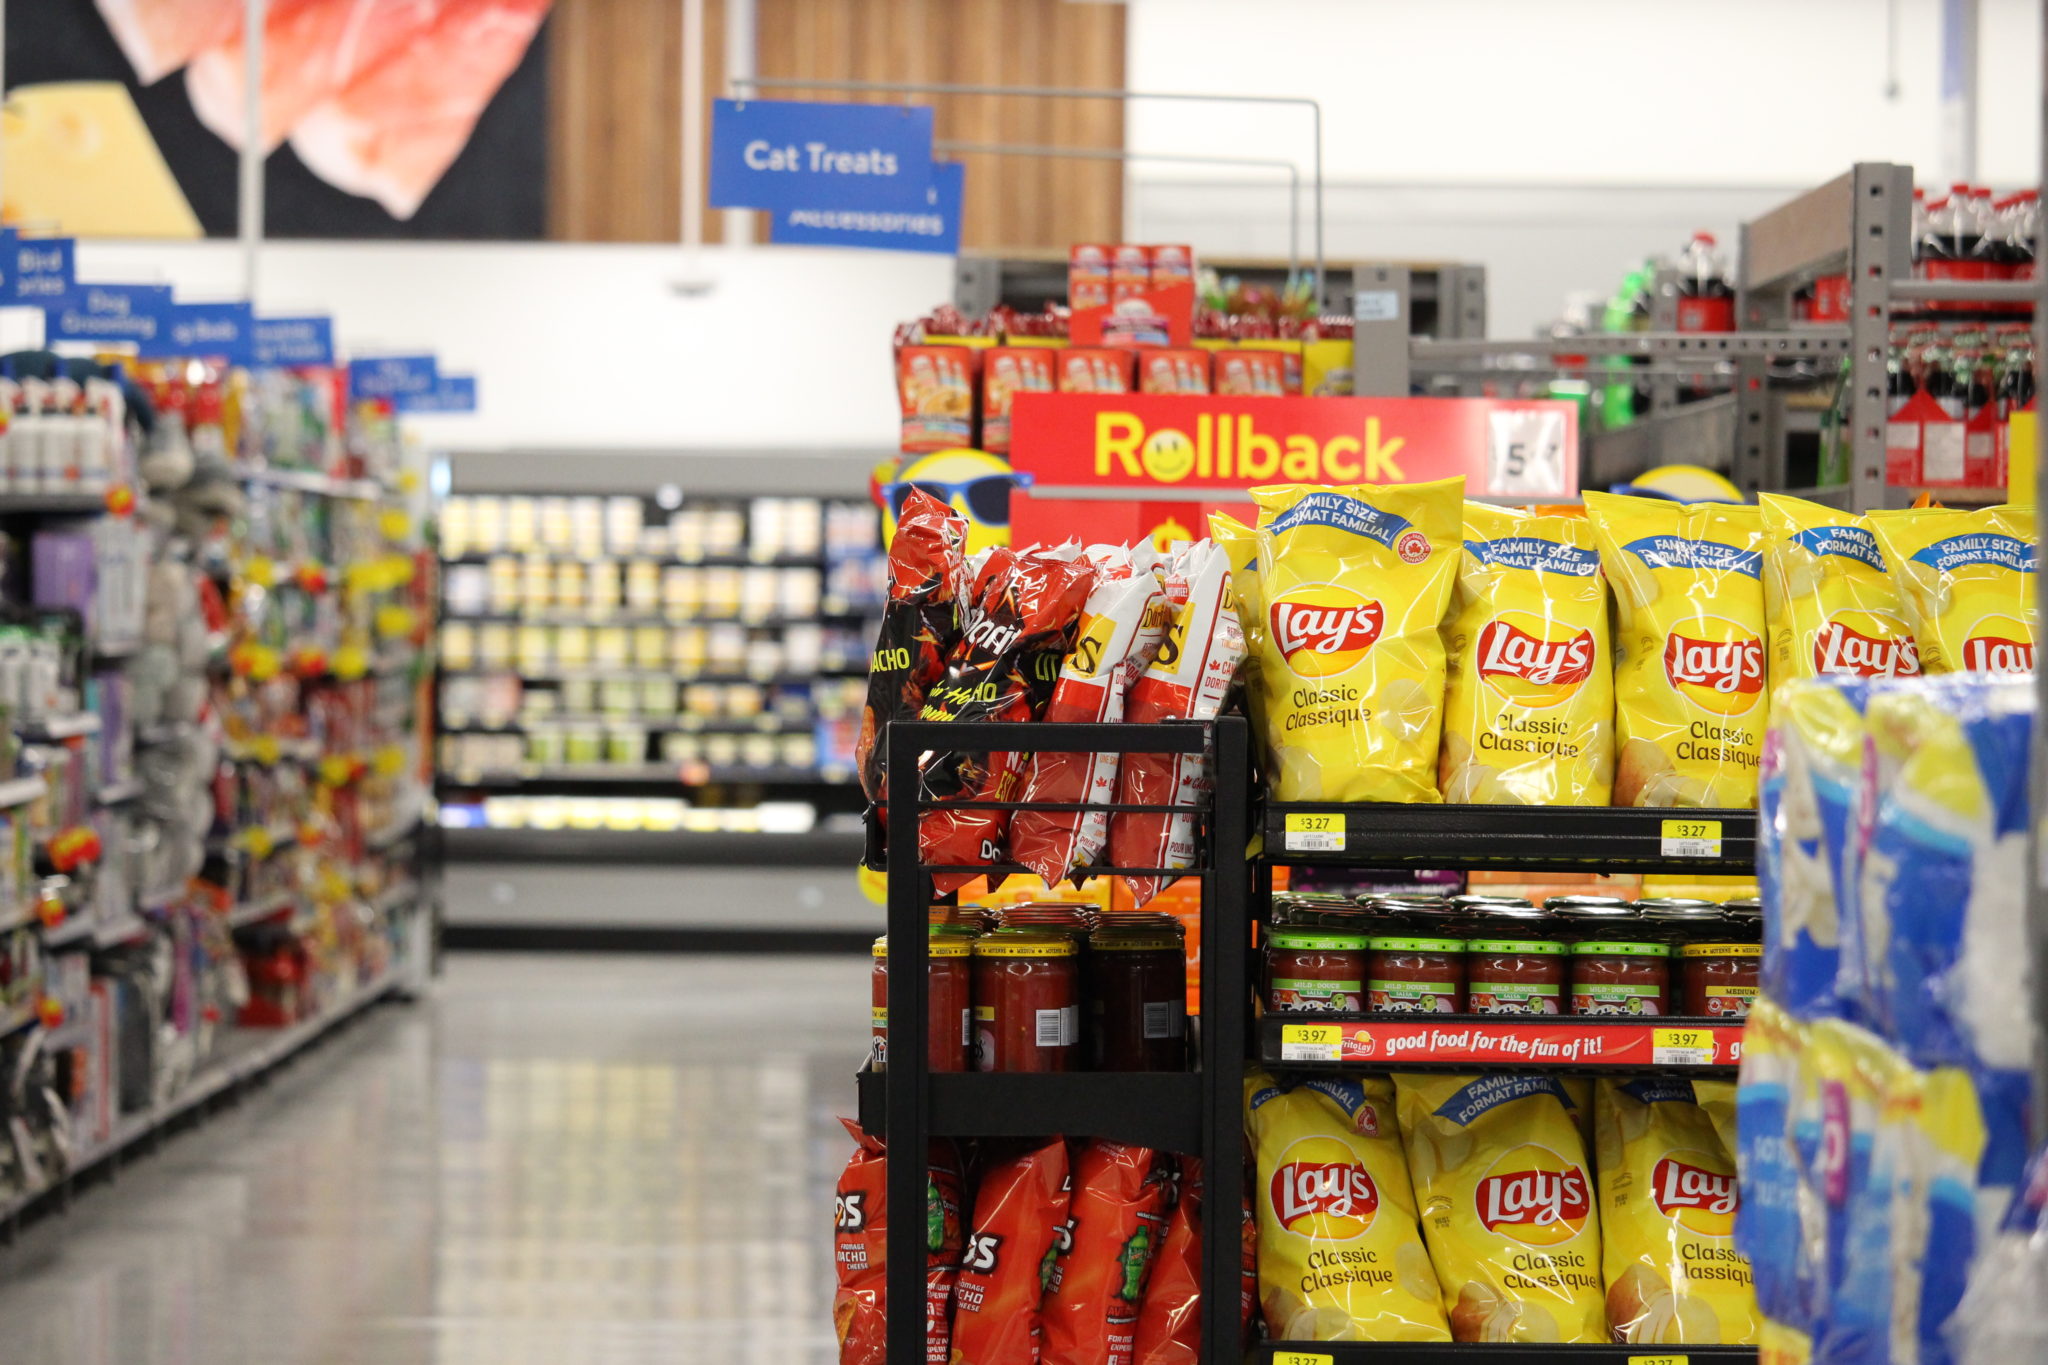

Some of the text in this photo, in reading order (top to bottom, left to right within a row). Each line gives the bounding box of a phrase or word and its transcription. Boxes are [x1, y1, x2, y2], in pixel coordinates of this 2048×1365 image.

[744, 140, 898, 176] Cat Treats
[1095, 411, 1406, 483] Rollback
[1344, 502, 1379, 523] SIZE
[1273, 510, 1328, 533] FORMAT
[1331, 512, 1390, 542] FAMILIAL
[1830, 528, 1876, 548] FAMILY
[1490, 543, 1582, 562] FAMILY SIZE
[1700, 543, 1734, 558] SIZE
[1816, 540, 1866, 557] FORMAT
[1936, 549, 1983, 569] FORMAT
[1942, 537, 2021, 555] FAMILY SIZE
[1690, 555, 1755, 574] FAMILIAL
[1279, 604, 1378, 654] Lay's
[1483, 623, 1589, 685] Lay's
[1822, 622, 1920, 677] Lay's
[1673, 636, 1761, 693] Lay's
[1293, 684, 1358, 708] Classic
[1285, 706, 1372, 732] Classique
[1496, 714, 1568, 735] Classic
[1479, 732, 1579, 759] Classique
[1690, 721, 1753, 746] Classic
[1676, 742, 1761, 768] Classique
[1386, 1030, 1603, 1060] good food for the fun of it!
[1458, 1085, 1511, 1123] FORMAT
[1283, 1164, 1370, 1219] Lay's
[1488, 1170, 1582, 1226] Lay's
[1663, 1160, 1738, 1214] Lay
[1308, 1247, 1377, 1269] Classic
[1513, 1251, 1586, 1271] Classic
[1300, 1266, 1393, 1294] Classique
[1503, 1270, 1597, 1291] Classique
[1289, 1357, 1318, 1365] $327
